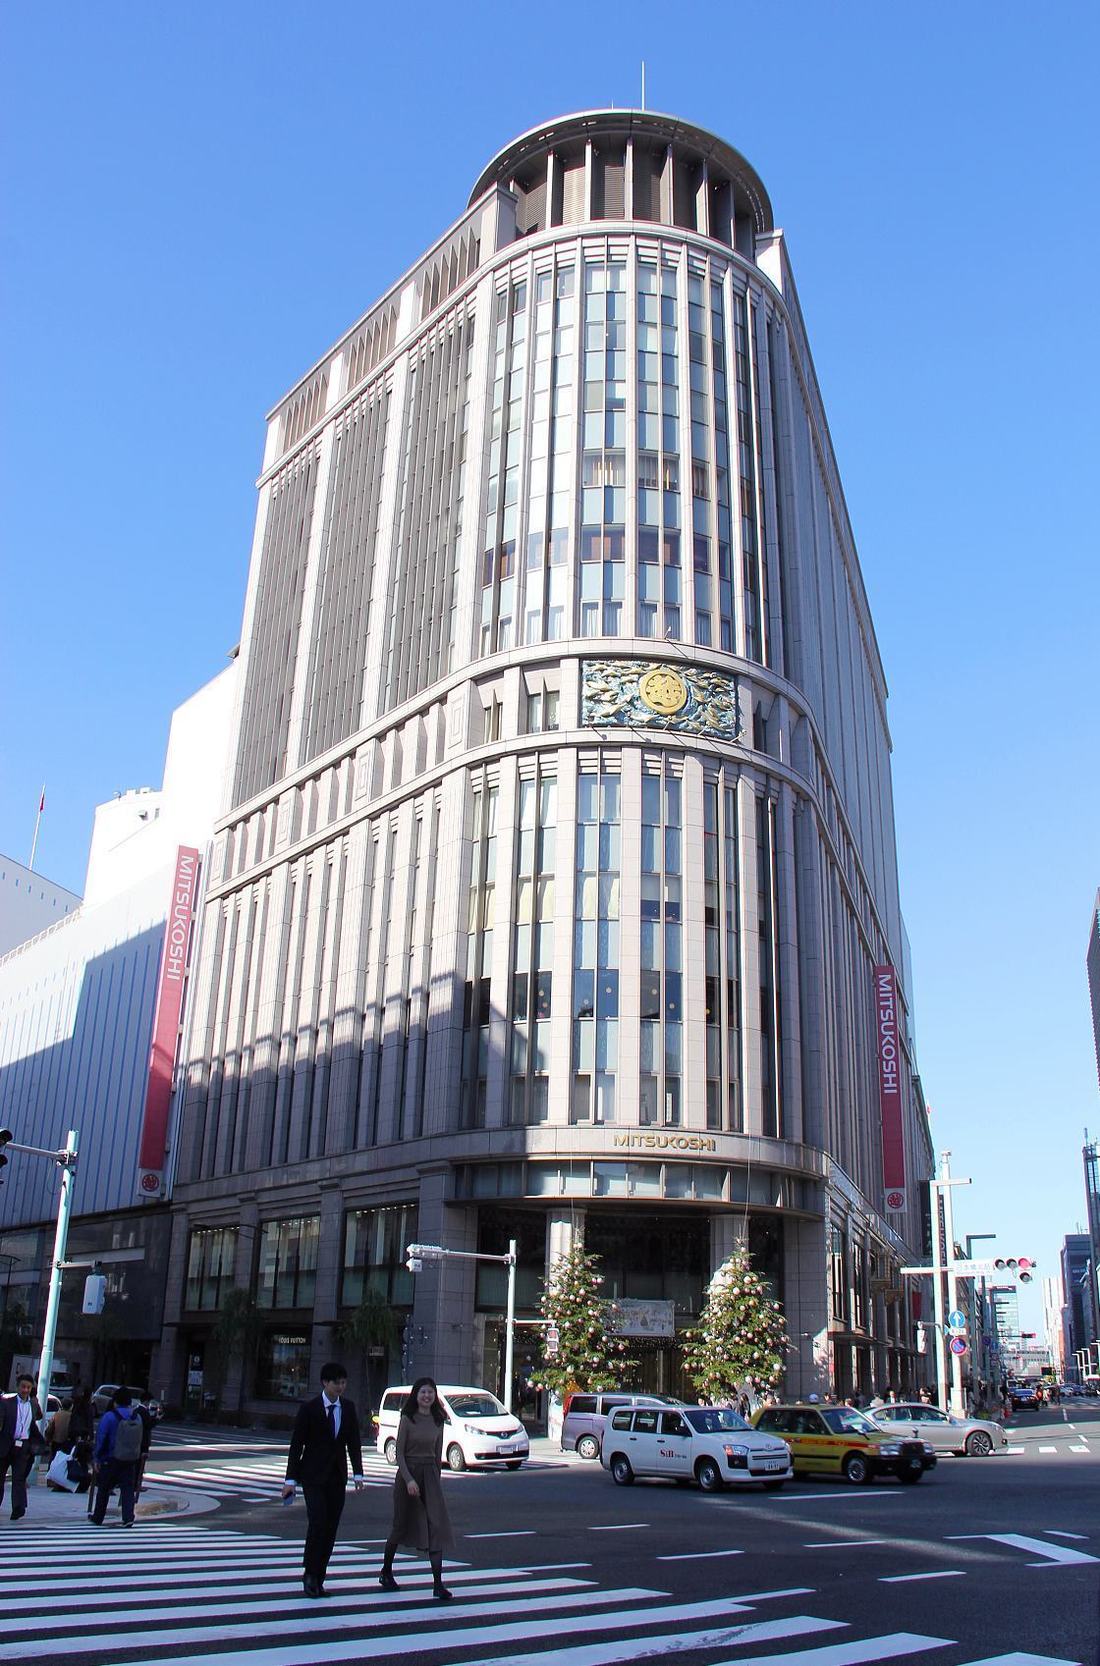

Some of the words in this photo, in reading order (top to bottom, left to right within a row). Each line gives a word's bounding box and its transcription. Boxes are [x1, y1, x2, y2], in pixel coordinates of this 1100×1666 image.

[167, 854, 194, 981] MITSUKOSHI
[878, 973, 898, 1094] MITSUKOSHI
[613, 1132, 717, 1152] MITSUKOSHI
